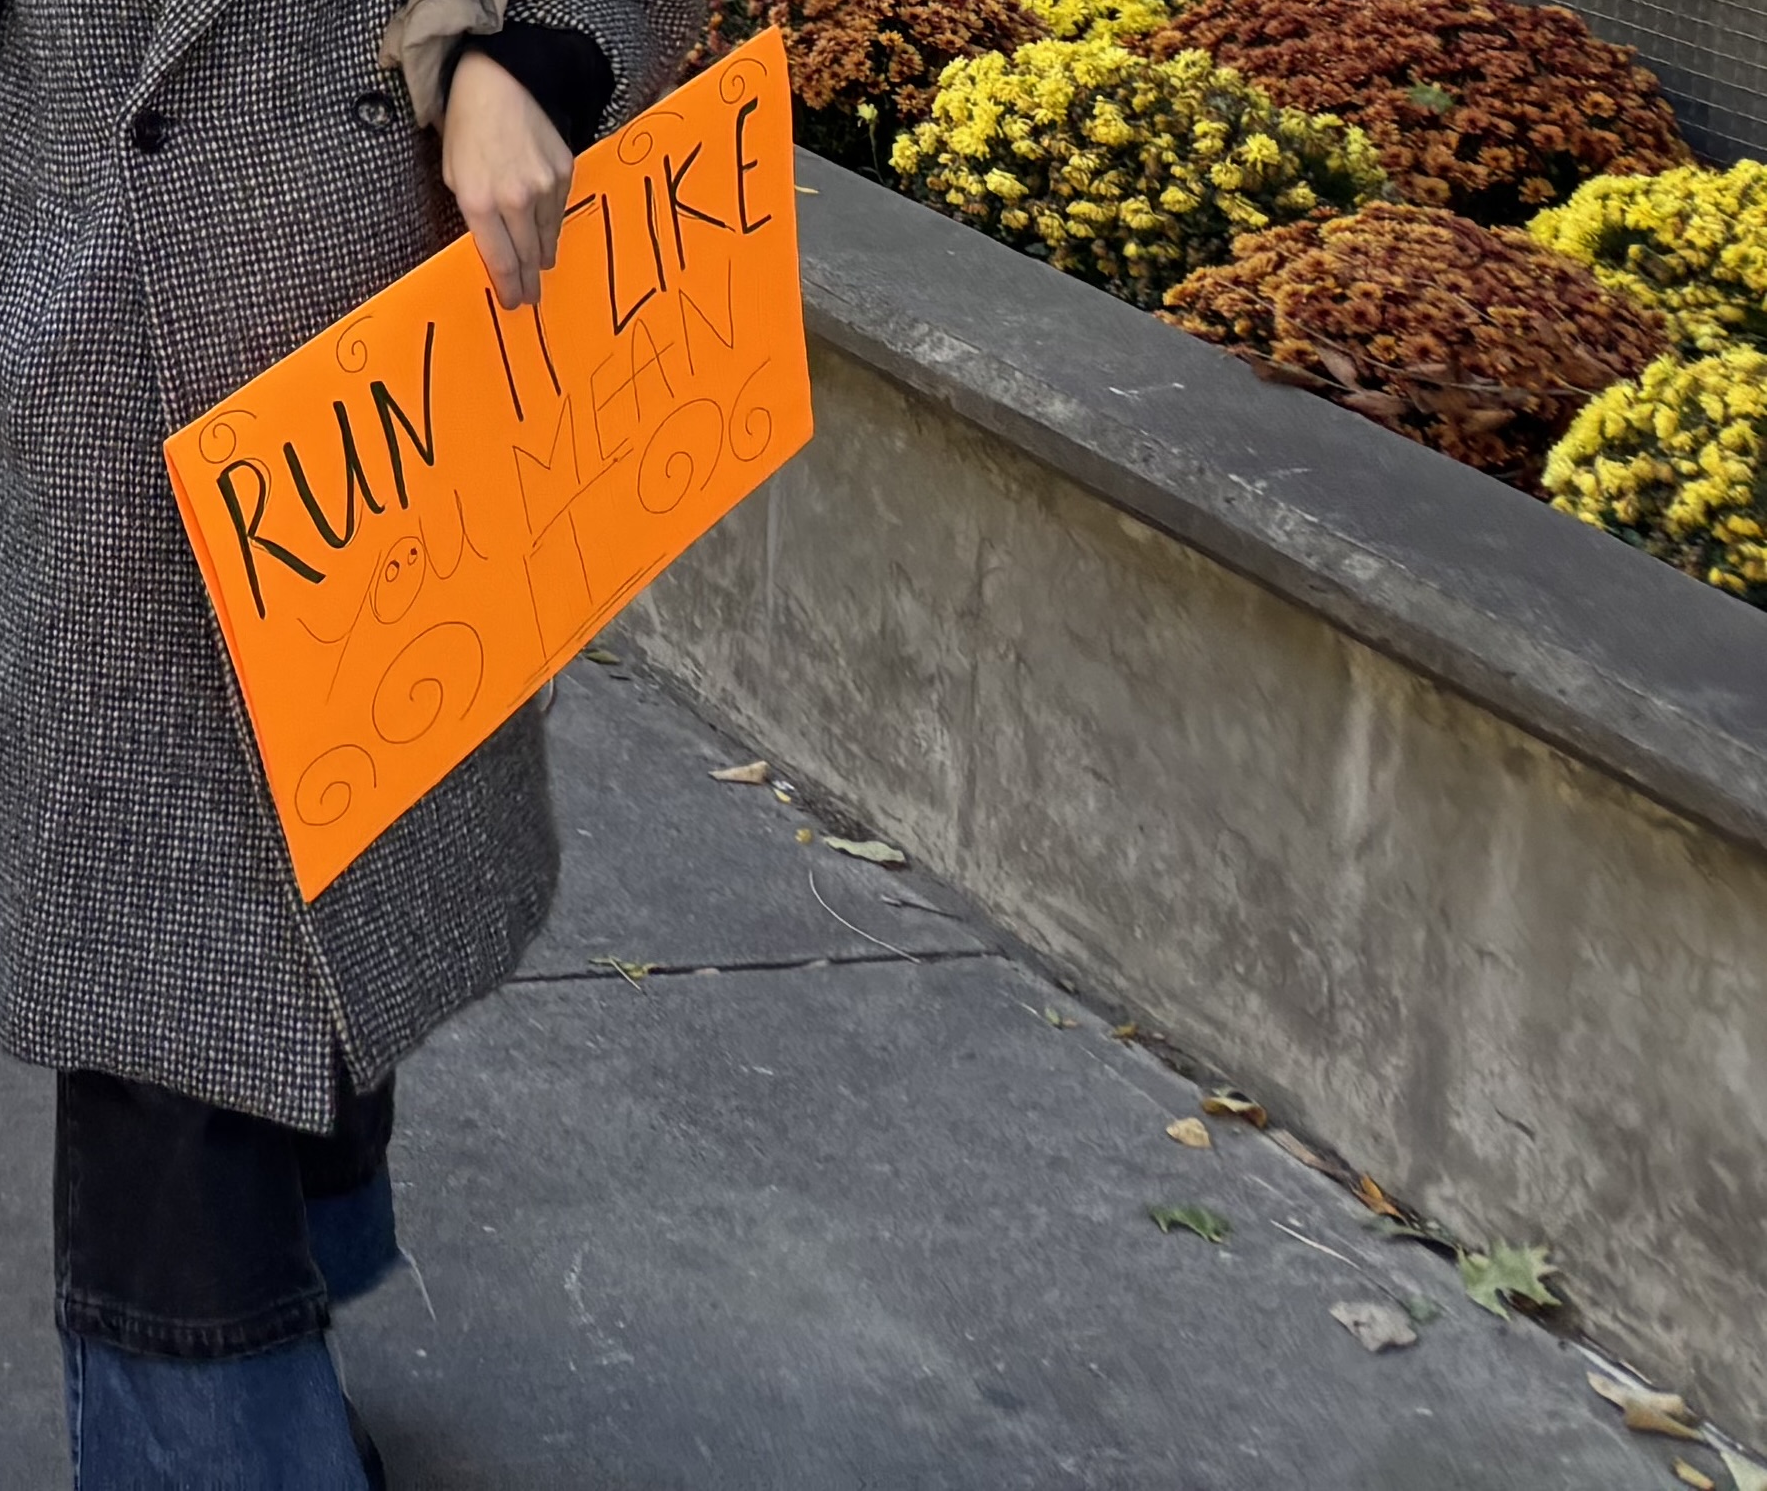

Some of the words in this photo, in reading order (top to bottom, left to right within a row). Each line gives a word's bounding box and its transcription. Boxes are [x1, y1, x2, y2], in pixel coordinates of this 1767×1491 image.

[216, 321, 437, 620] RUN
[601, 97, 772, 336] LIKE
[512, 258, 734, 535] MEAN
